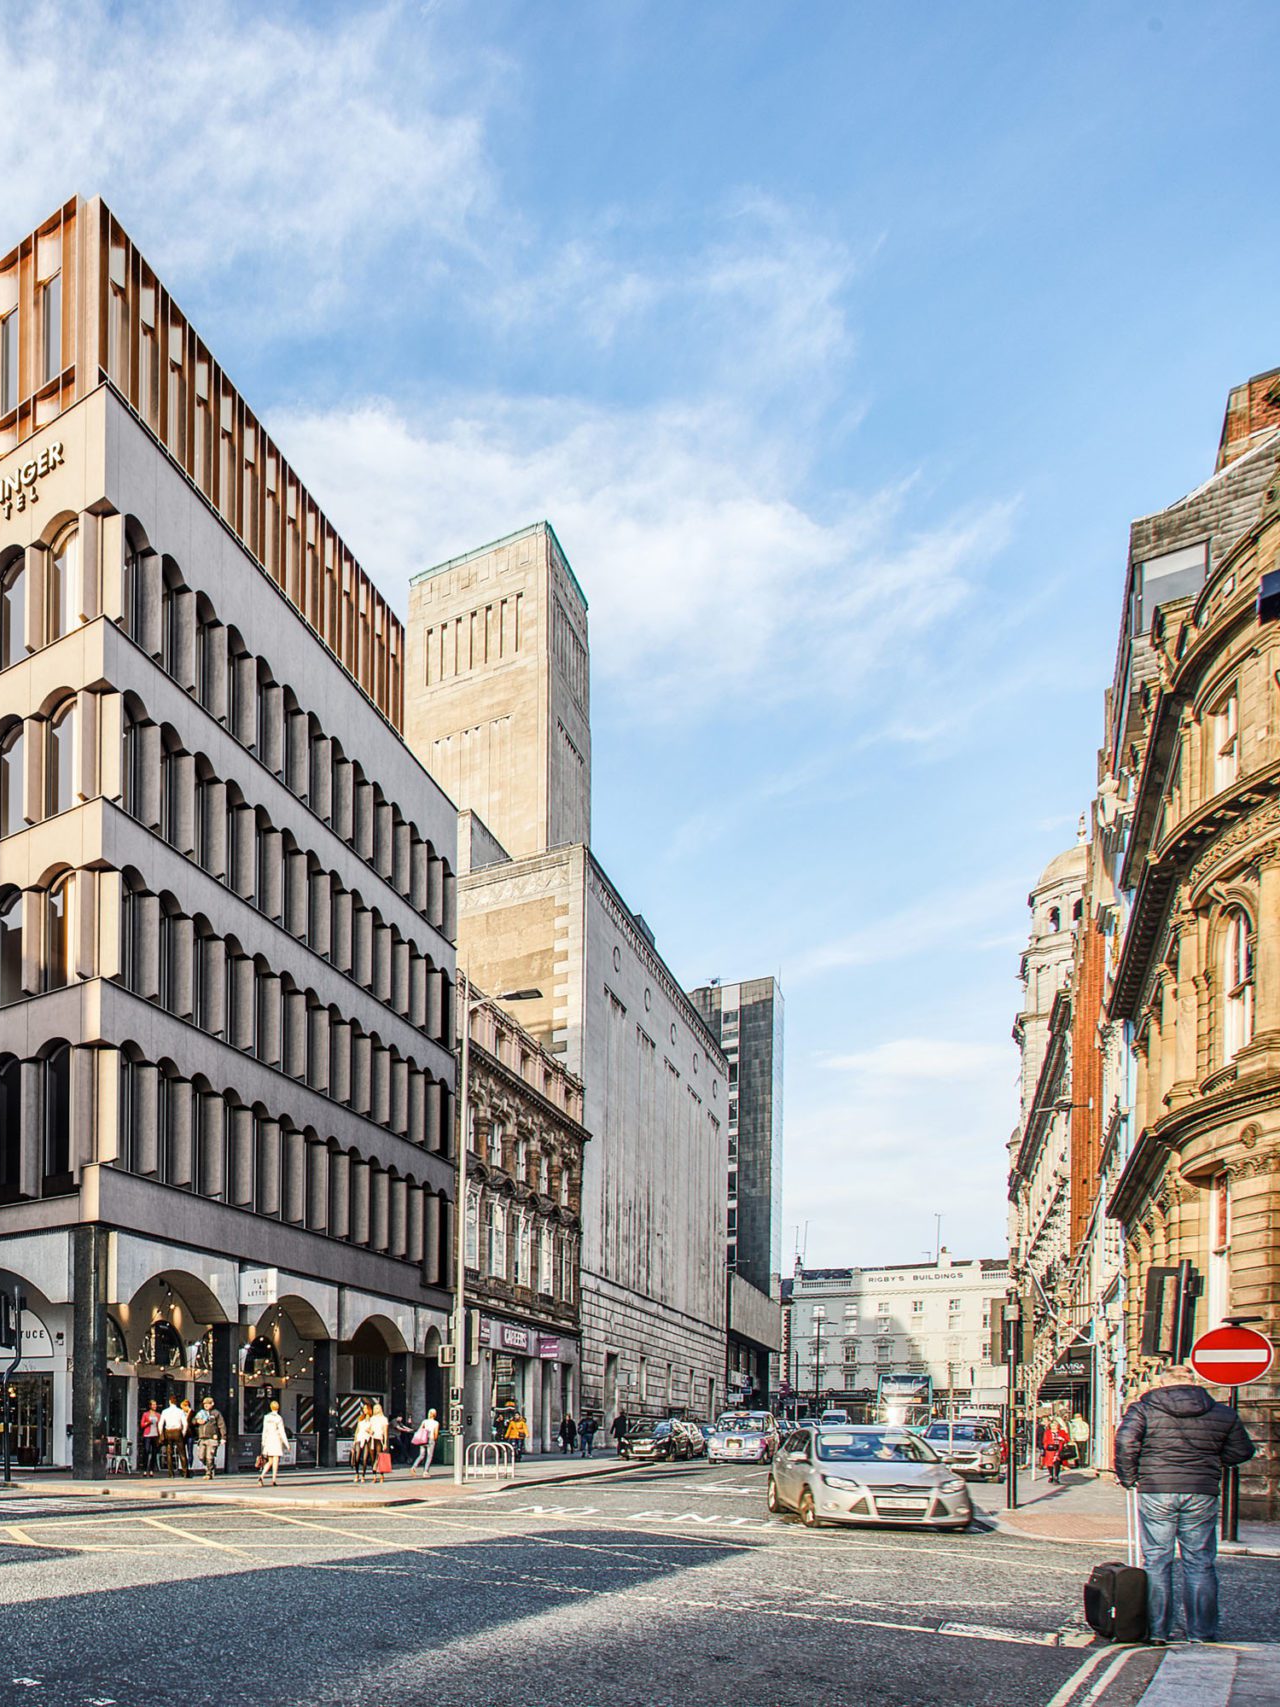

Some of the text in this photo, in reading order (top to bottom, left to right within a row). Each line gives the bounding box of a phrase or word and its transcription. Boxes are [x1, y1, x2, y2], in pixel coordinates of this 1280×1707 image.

[868, 1272, 964, 1283] RIGBY'S BUILDINGS
[510, 1505, 600, 1516] NO
